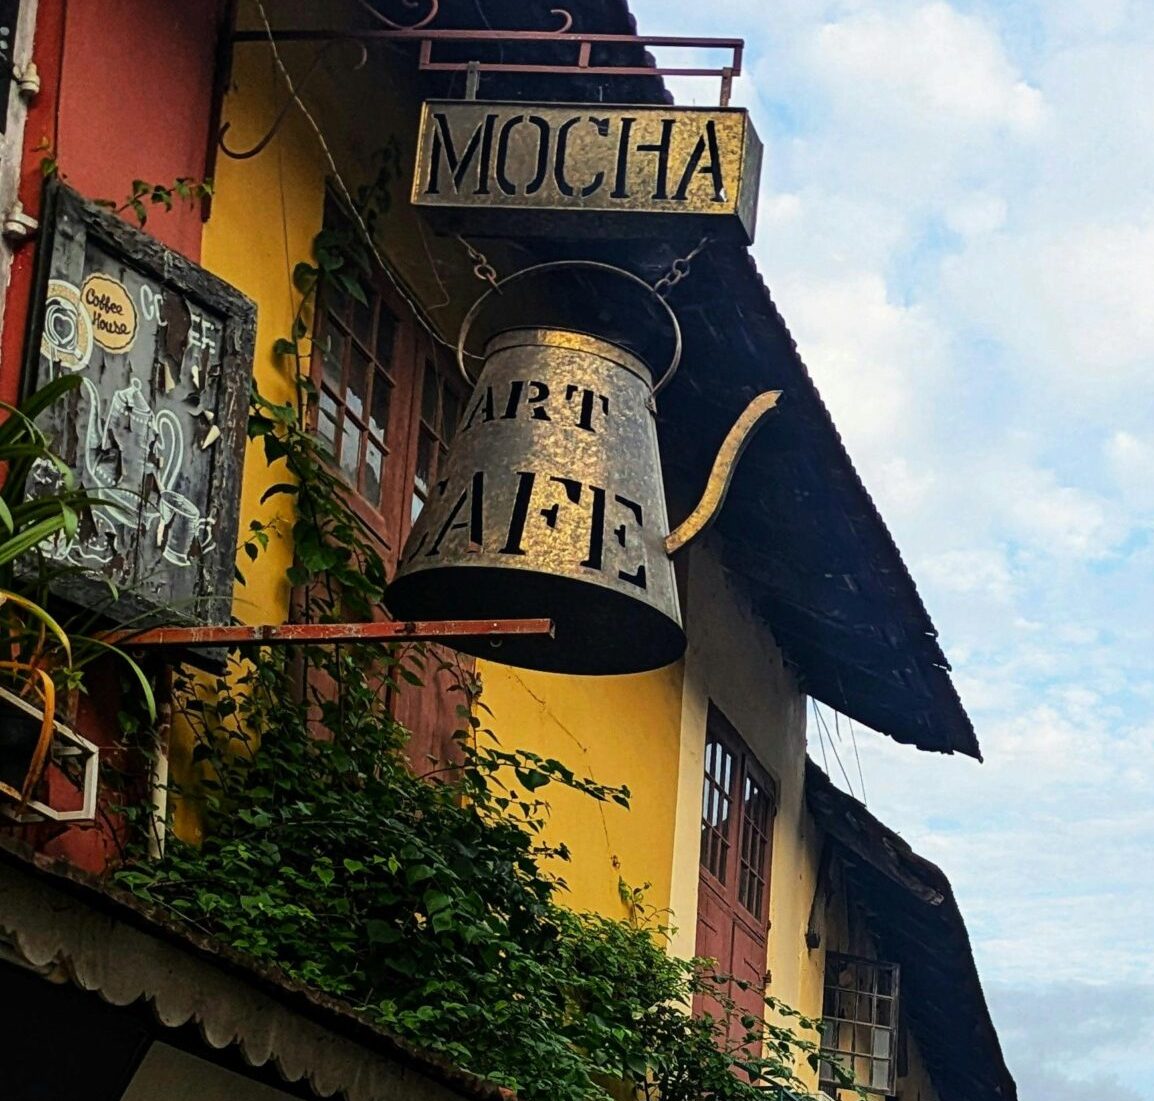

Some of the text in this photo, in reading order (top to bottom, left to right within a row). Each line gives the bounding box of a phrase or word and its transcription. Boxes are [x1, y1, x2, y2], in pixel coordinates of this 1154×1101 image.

[424, 112, 729, 203] MOCHA
[86, 288, 124, 316] Coffee
[92, 310, 131, 335] House
[462, 380, 609, 433] ART
